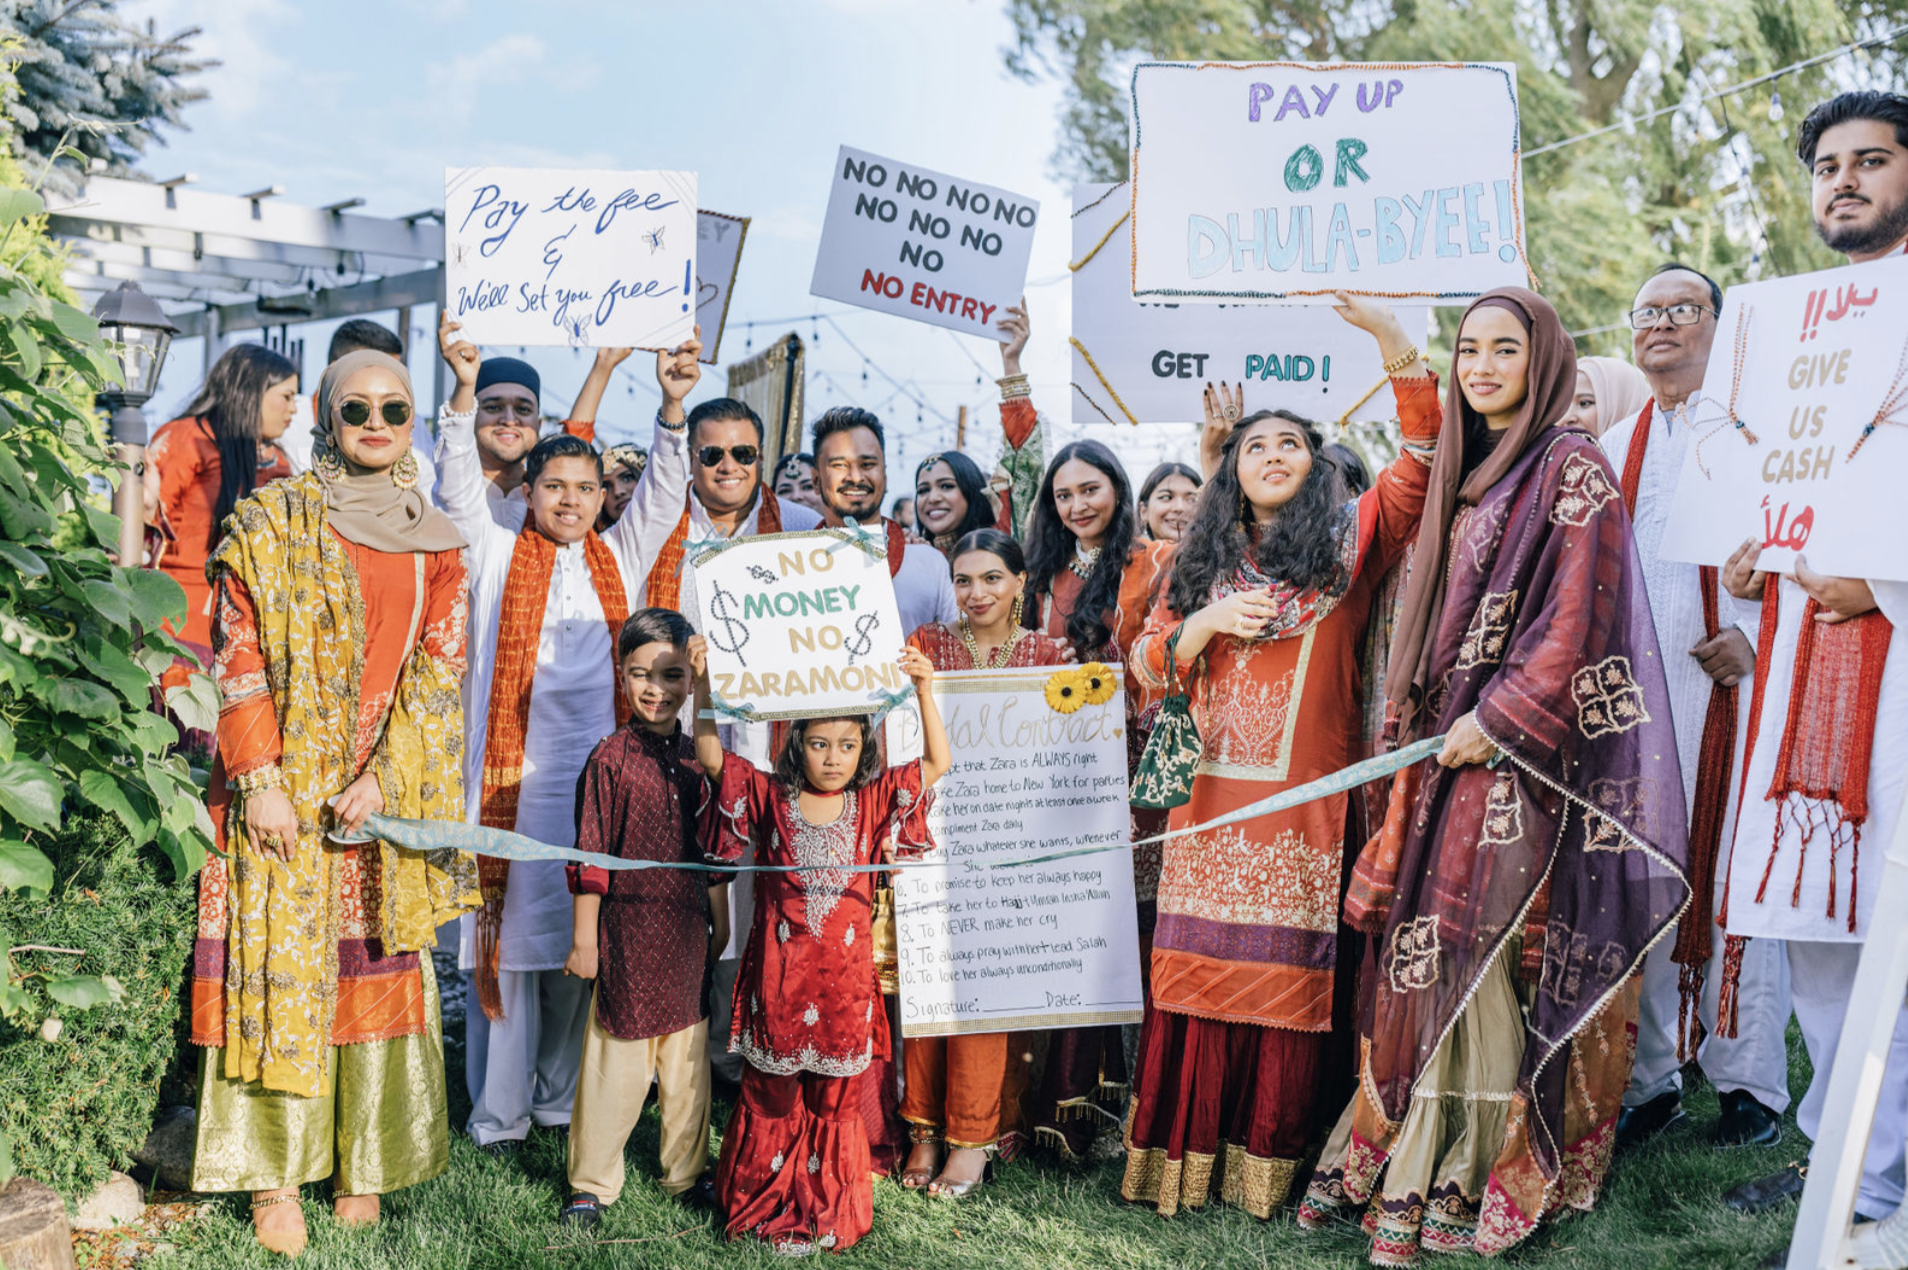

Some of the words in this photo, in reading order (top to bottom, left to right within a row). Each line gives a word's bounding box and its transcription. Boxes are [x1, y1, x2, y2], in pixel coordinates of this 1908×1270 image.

[1248, 82, 1340, 122] PAY
[1356, 79, 1404, 113] UP
[1283, 137, 1371, 193] OR
[843, 157, 887, 188] NO
[896, 170, 937, 201] NO
[946, 185, 990, 214] NO
[993, 198, 1036, 228] NO
[459, 185, 529, 257] Pay
[541, 187, 596, 213] the
[595, 189, 679, 234] fee
[855, 192, 898, 223] NO
[908, 209, 951, 239] NO
[960, 224, 1003, 256] NO
[1187, 179, 1516, 280] DHULA-BYEE!
[899, 240, 944, 272] NO
[458, 279, 510, 317] We'll
[516, 282, 549, 313] Set
[553, 290, 592, 326] you
[861, 268, 904, 299] NO
[910, 282, 997, 325] ENTRY
[1151, 349, 1210, 379] GET
[1787, 349, 1852, 390] GIVE
[1788, 405, 1827, 440] US
[1761, 445, 1835, 484] CASH
[777, 548, 834, 577] NO
[743, 584, 861, 620] MONEY
[788, 625, 843, 654] NO
[714, 662, 902, 699] ZARAMONI
[997, 695, 1112, 748] Contract
[964, 760, 987, 772] that
[990, 757, 1016, 770] Zara
[1021, 759, 1029, 768] is
[1031, 751, 1070, 767] ALWAYS
[1073, 752, 1098, 768] right
[955, 781, 980, 797] Zara
[984, 780, 1008, 794] home
[1009, 779, 1021, 791] to
[1023, 777, 1044, 791] New
[1049, 774, 1070, 789] York
[1072, 775, 1088, 789] for
[1093, 775, 1125, 792] parties
[953, 802, 969, 816] her
[970, 803, 982, 814] on
[982, 802, 1004, 813] date
[1005, 799, 1033, 813] nights
[1035, 798, 1045, 808] at
[1045, 797, 1065, 807] least
[1092, 794, 1119, 804] week
[981, 819, 1001, 831] Zara
[1003, 819, 1023, 832] daily
[950, 840, 974, 856] Zara
[976, 840, 1017, 853] whatever
[1020, 838, 1036, 849] she
[1075, 830, 1122, 845] whenever
[896, 880, 907, 897] 6.
[911, 878, 929, 893] To
[935, 877, 972, 892] promise
[991, 873, 1016, 887] keep
[1018, 873, 1034, 884] her
[1037, 870, 1071, 886] always
[1073, 870, 1102, 886] happy
[896, 904, 908, 918] 7.
[912, 901, 929, 915] To
[936, 901, 962, 914] take
[965, 899, 982, 911] her
[985, 896, 998, 908] to
[1001, 895, 1023, 909] Hajj
[900, 923, 914, 942] 8.
[919, 922, 935, 938] To
[940, 917, 980, 935] NEVER
[984, 918, 1014, 931] make
[1016, 916, 1032, 927] her
[1039, 914, 1058, 929] cry
[900, 948, 914, 968] 9.
[916, 946, 935, 964] To
[939, 949, 975, 964] always
[977, 946, 1001, 959] pray
[1050, 940, 1073, 954] lead
[1076, 936, 1107, 952] Salah
[901, 970, 916, 985] 10.
[917, 969, 932, 983] To
[939, 967, 960, 983] love
[962, 968, 977, 980] her
[980, 965, 1014, 978] always
[1016, 958, 1083, 974] unconditionally
